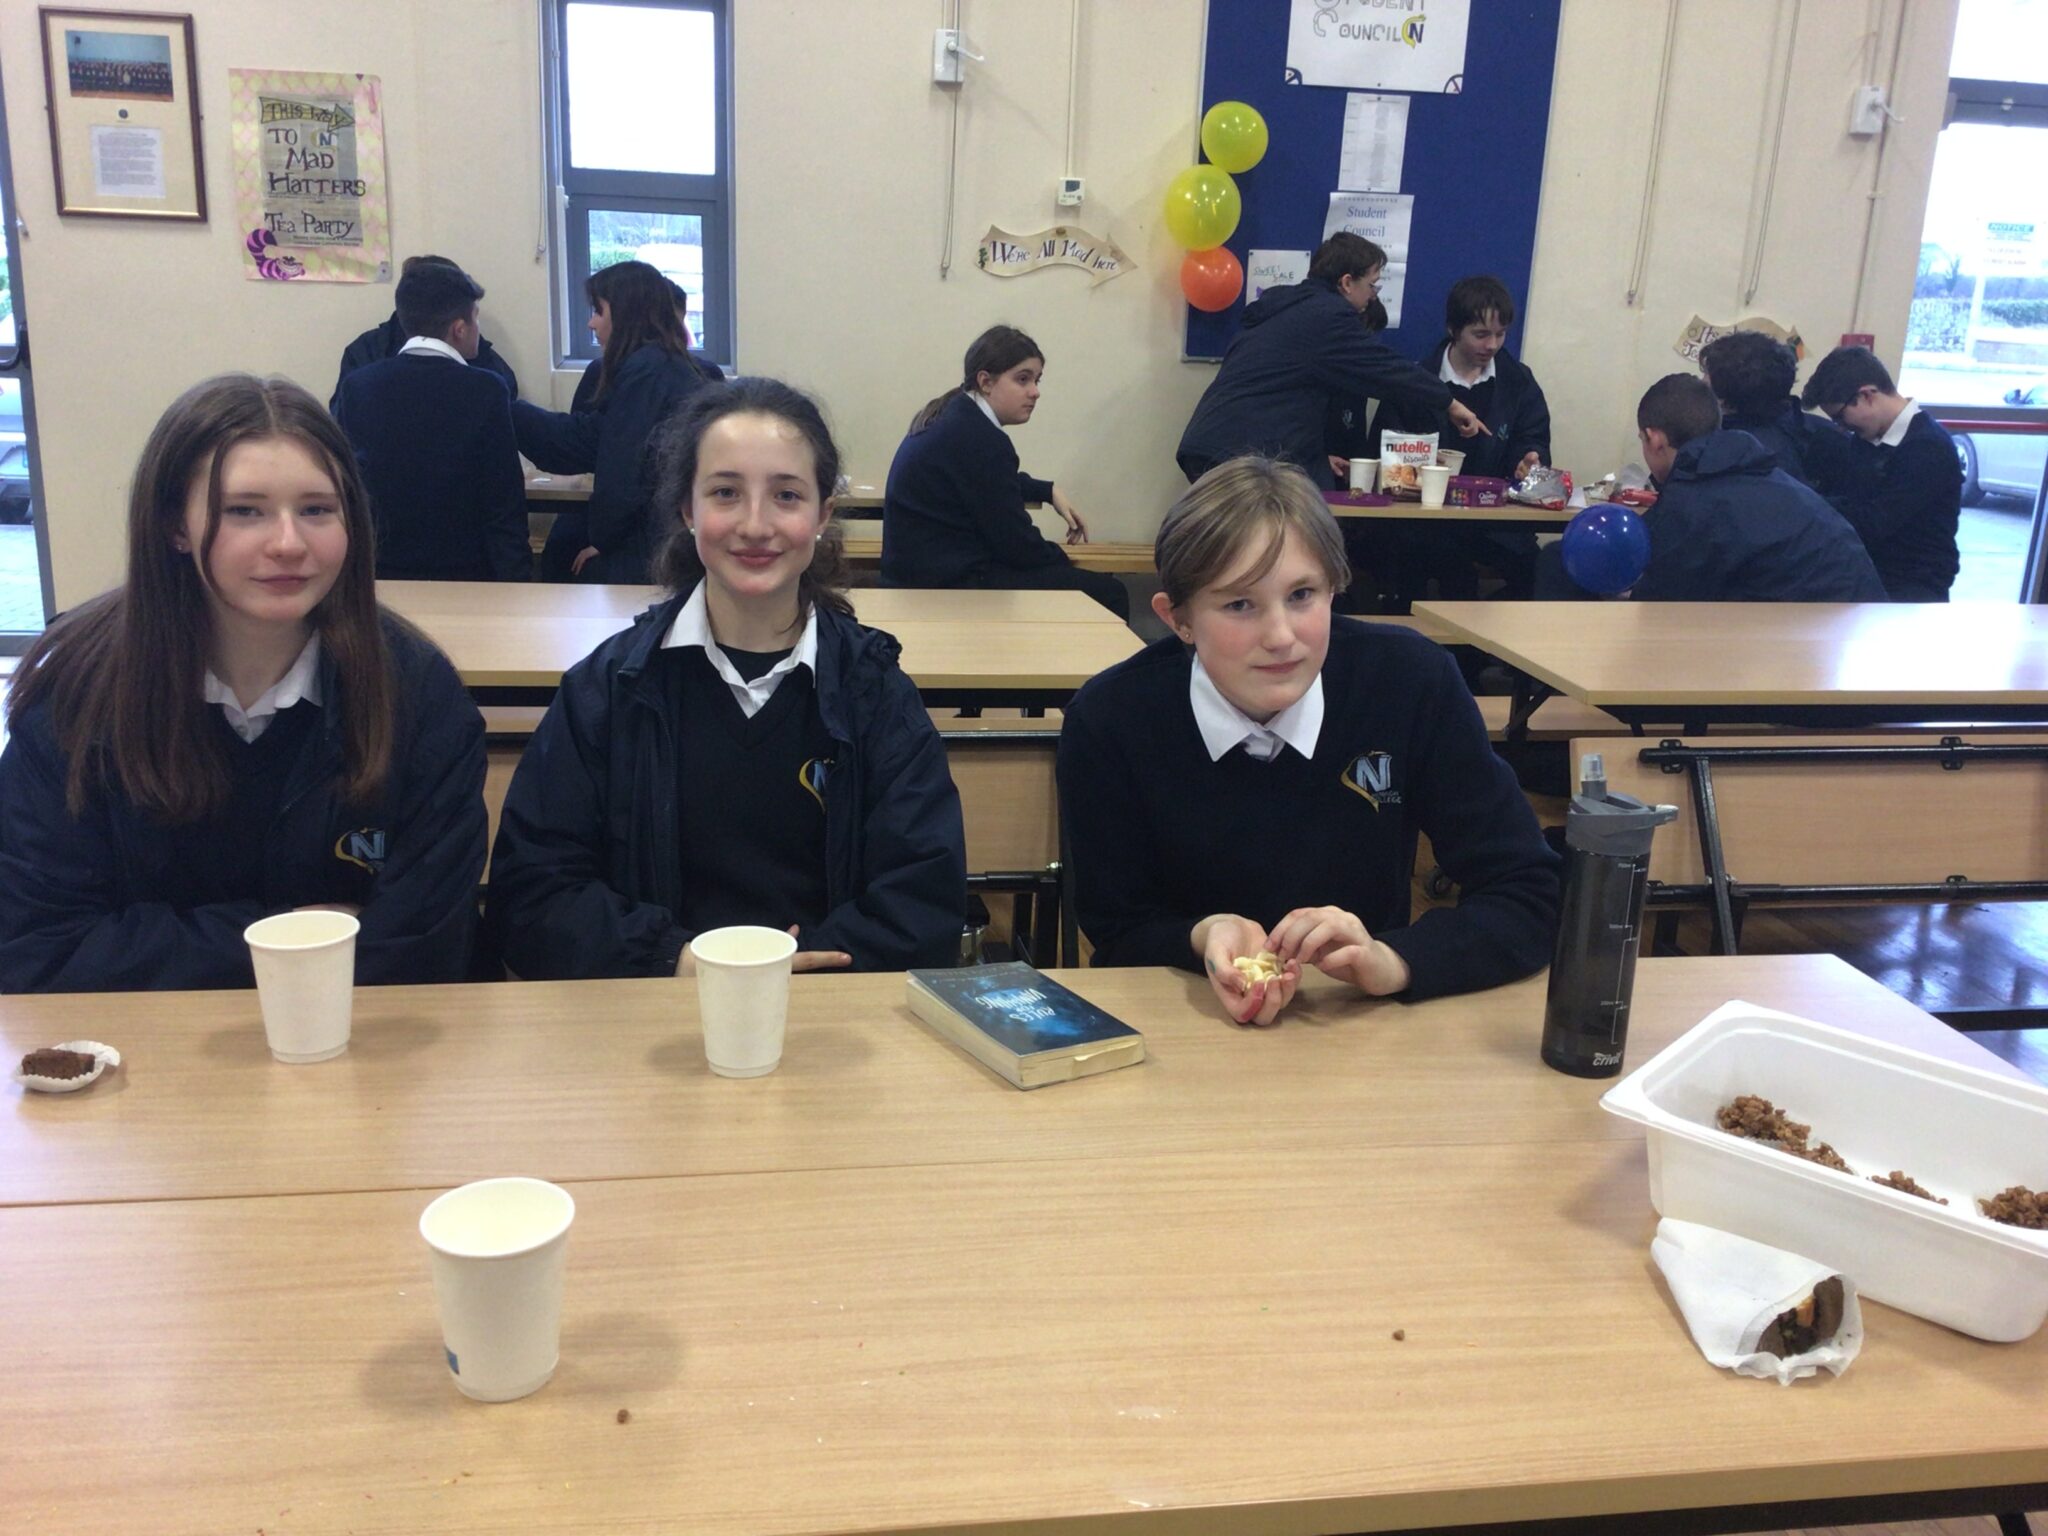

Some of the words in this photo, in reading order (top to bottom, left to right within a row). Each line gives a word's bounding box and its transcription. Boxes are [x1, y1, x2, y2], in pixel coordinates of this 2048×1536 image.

[265, 103, 303, 120] THIS
[267, 128, 298, 145] TO
[1347, 206, 1387, 219] Student
[1386, 441, 1431, 453] nutella
